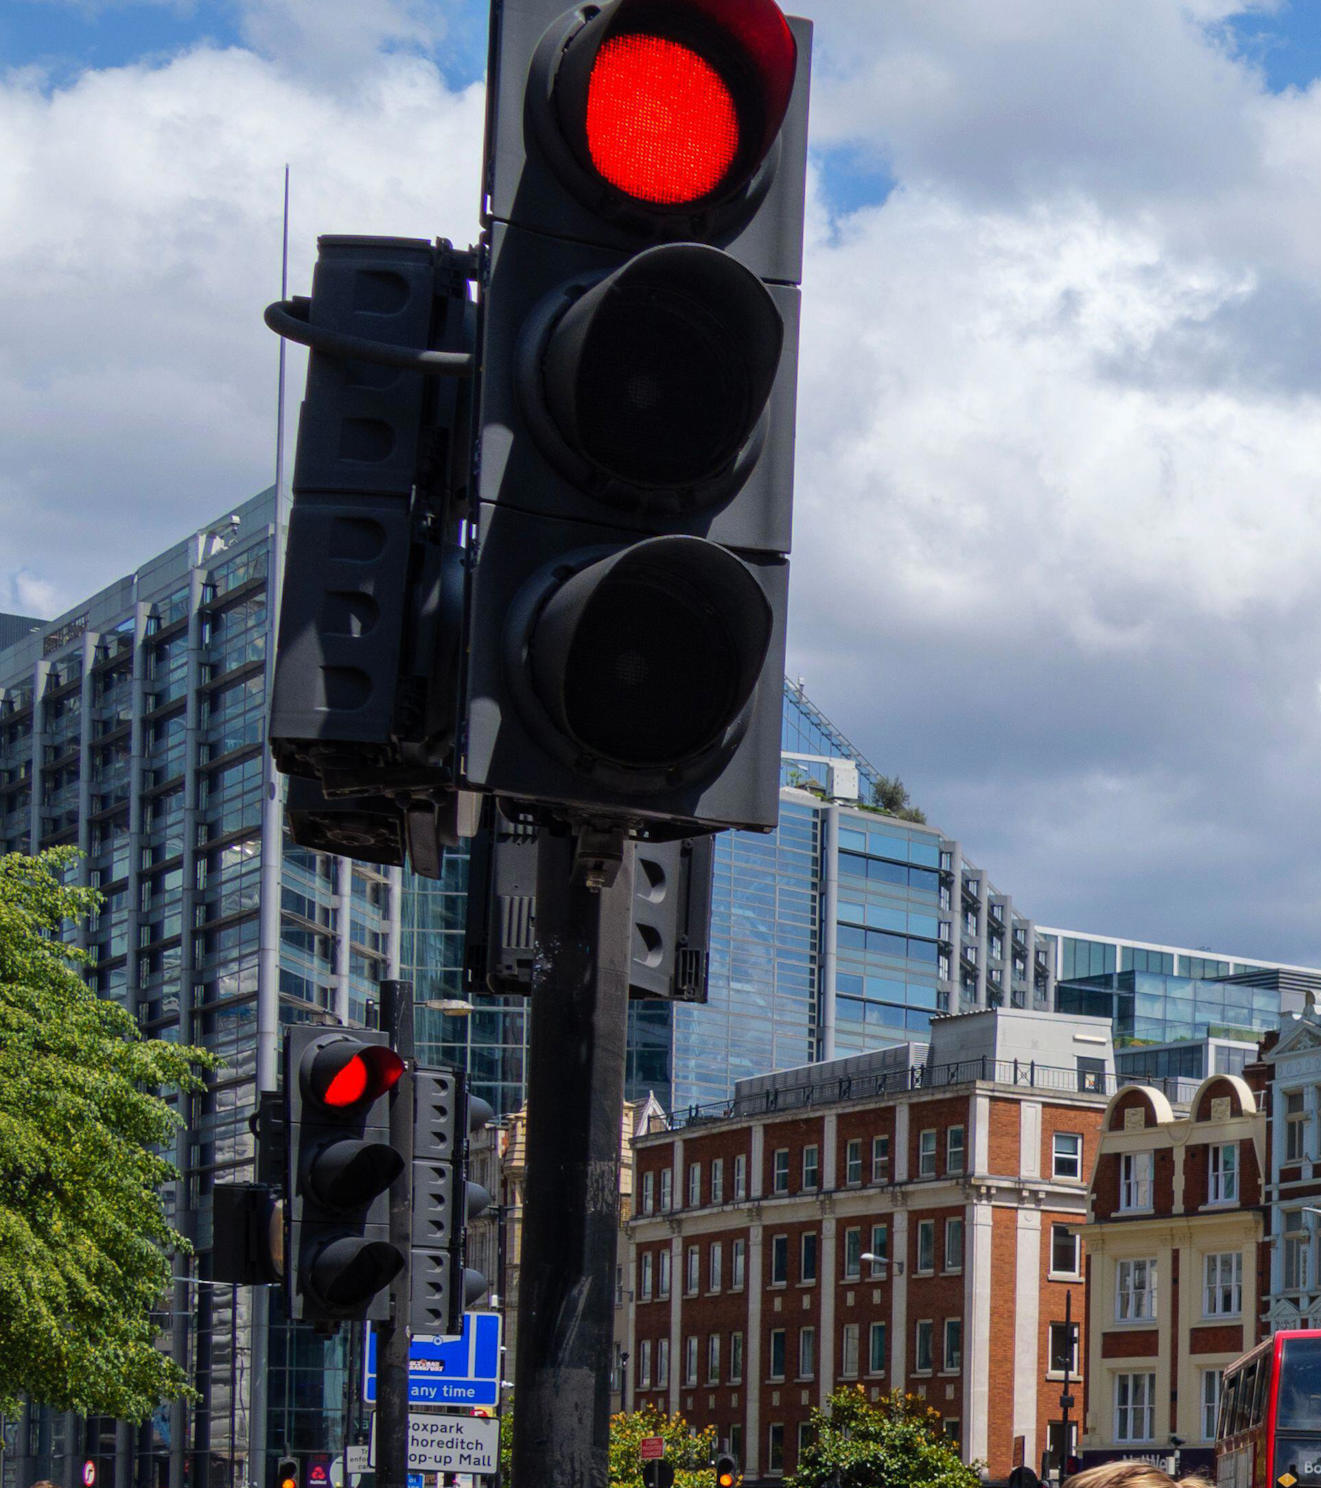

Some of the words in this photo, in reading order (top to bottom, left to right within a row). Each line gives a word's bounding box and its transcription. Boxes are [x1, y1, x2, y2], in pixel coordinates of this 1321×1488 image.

[411, 1386, 437, 1398] any
[442, 1385, 476, 1398] time
[408, 1436, 484, 1451] horeditch
[408, 1453, 453, 1467] op-up
[459, 1454, 492, 1468] Mall
